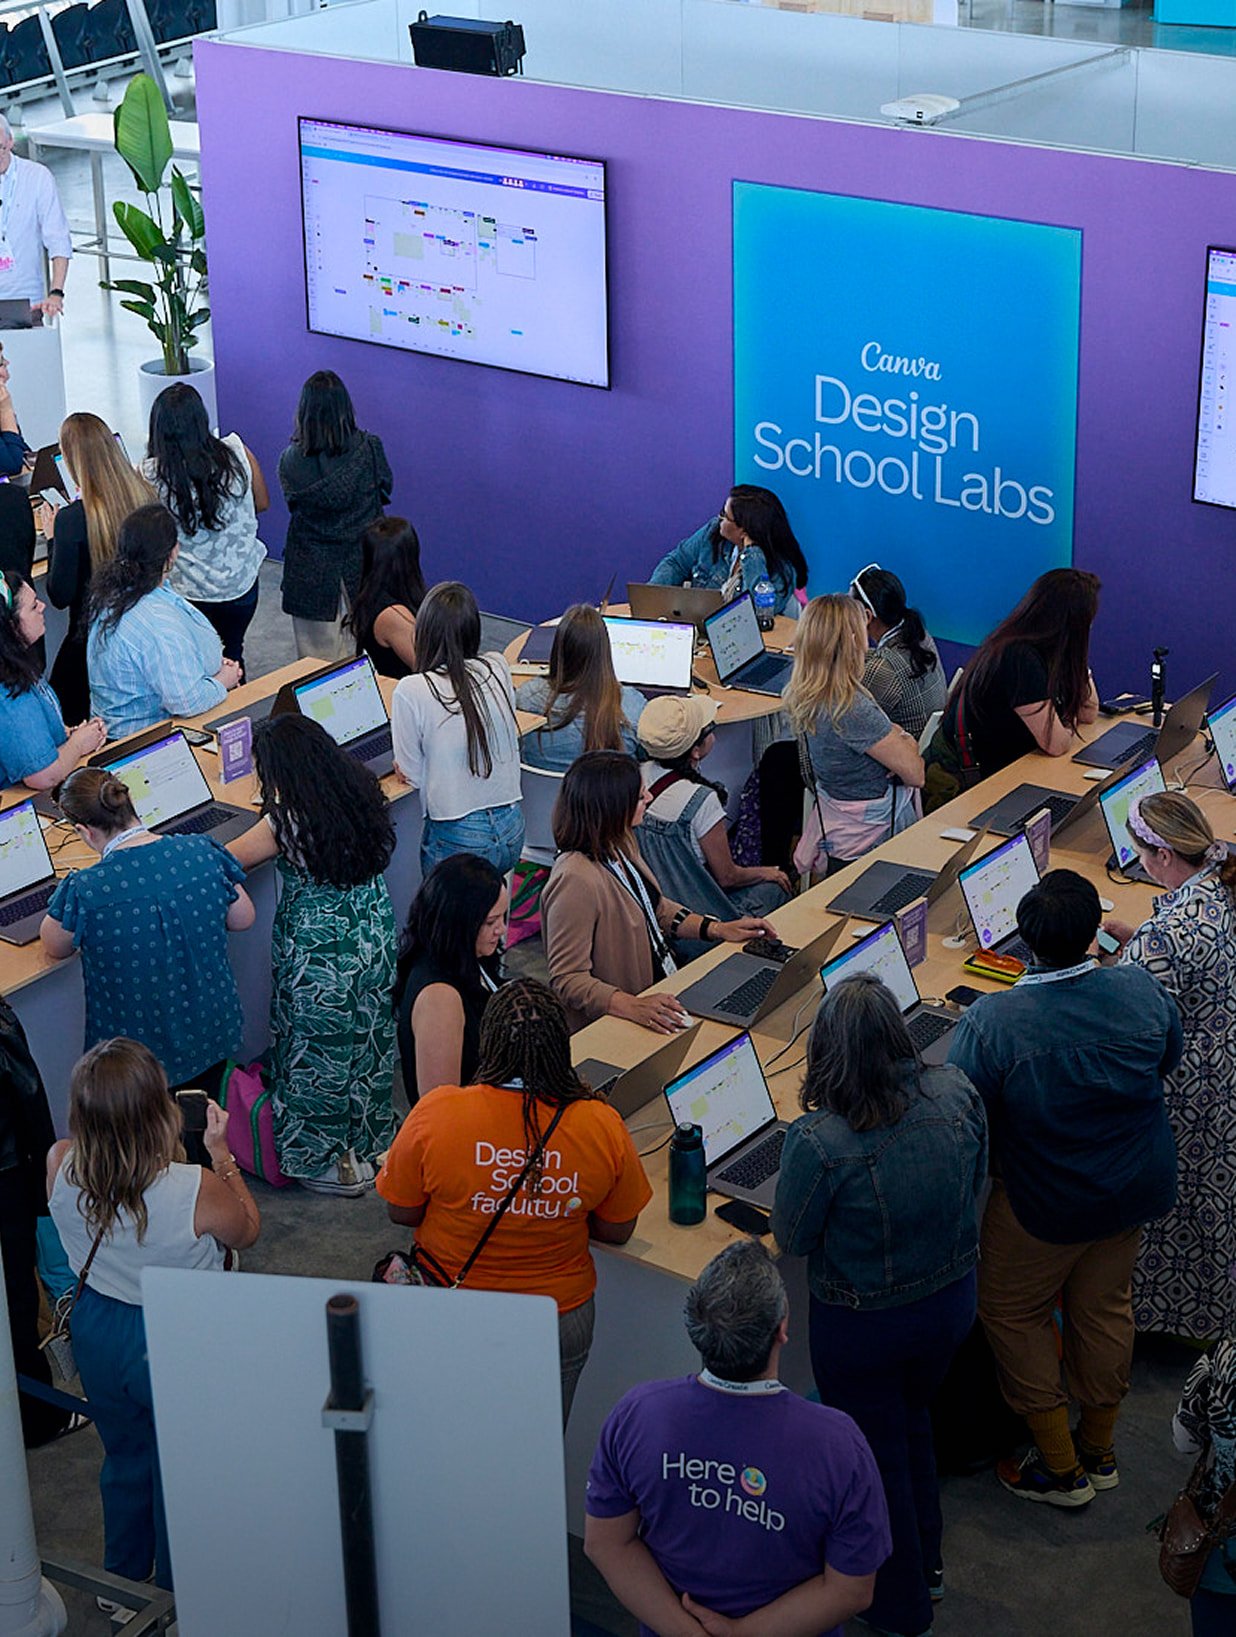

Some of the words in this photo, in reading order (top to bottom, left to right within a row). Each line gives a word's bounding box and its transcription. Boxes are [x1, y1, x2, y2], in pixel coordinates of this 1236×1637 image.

[861, 341, 942, 381] Canva
[815, 374, 980, 454] Design
[753, 421, 924, 501] School
[934, 455, 1056, 525] Labs
[662, 1453, 736, 1484] Here
[688, 1483, 721, 1509] to
[725, 1488, 786, 1531] help
